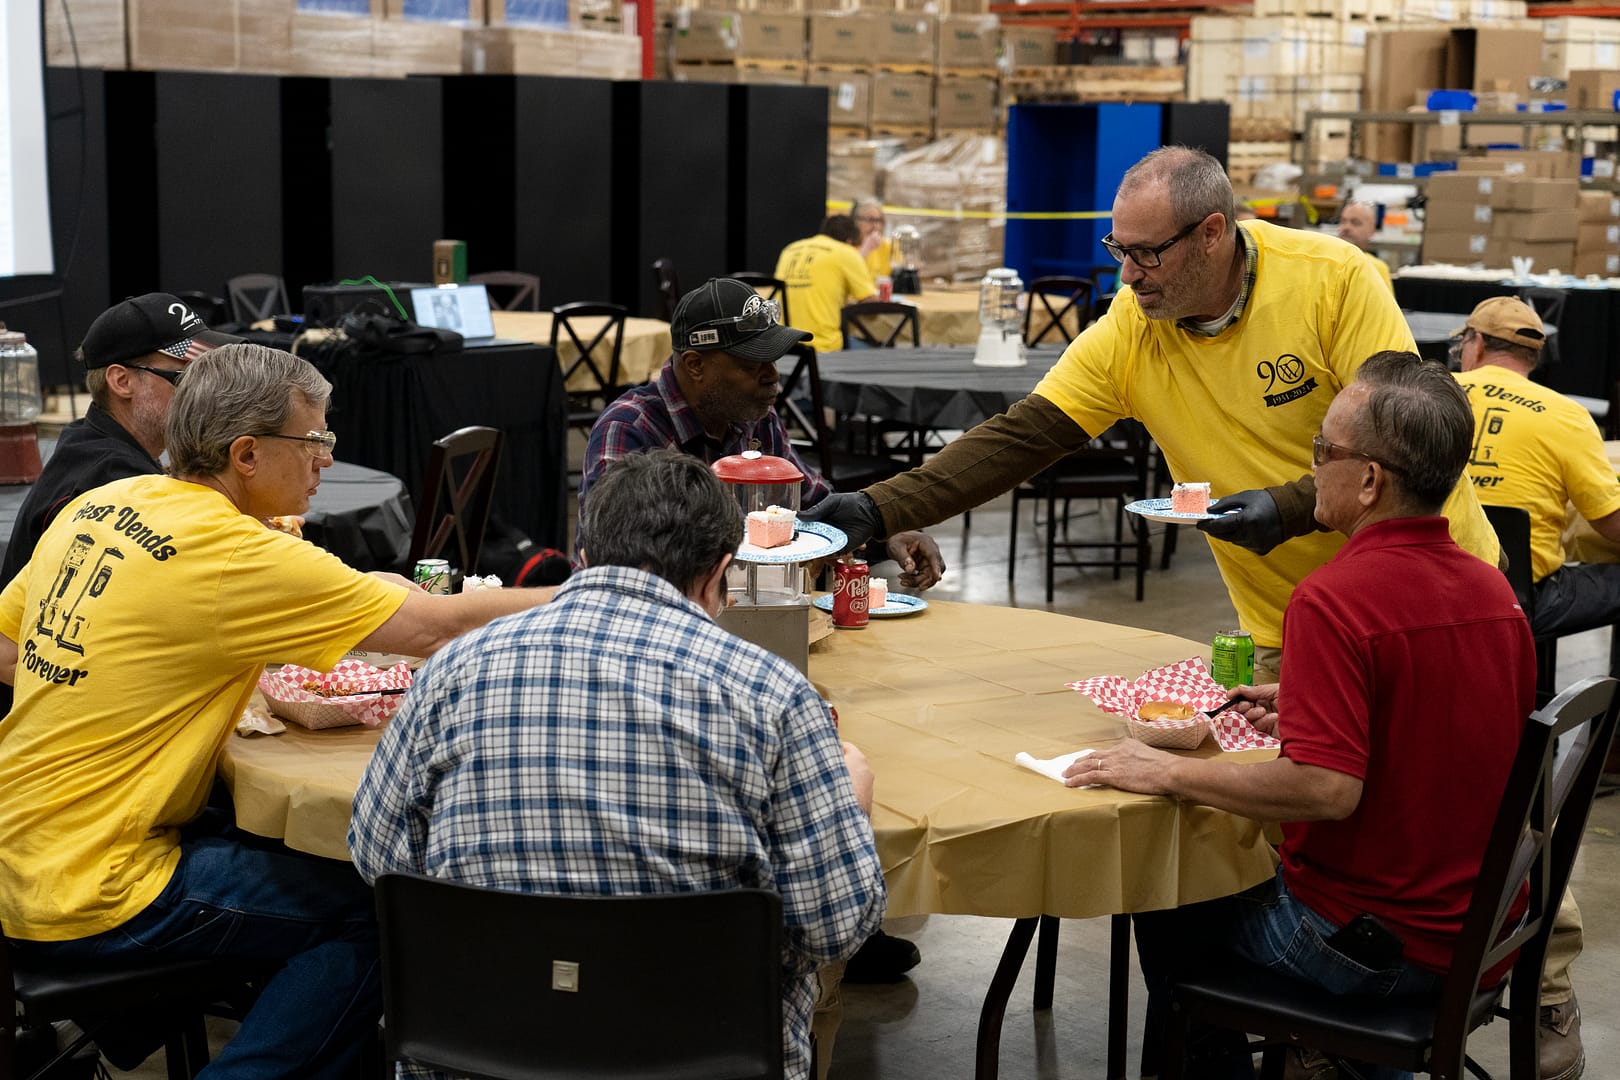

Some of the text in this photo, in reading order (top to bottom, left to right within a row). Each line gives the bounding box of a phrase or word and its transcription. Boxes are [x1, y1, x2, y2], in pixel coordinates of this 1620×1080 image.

[1482, 384, 1546, 413] Vends
[114, 506, 178, 562] Vends
[850, 578, 870, 598] Pepp
[22, 639, 88, 687] Forever
